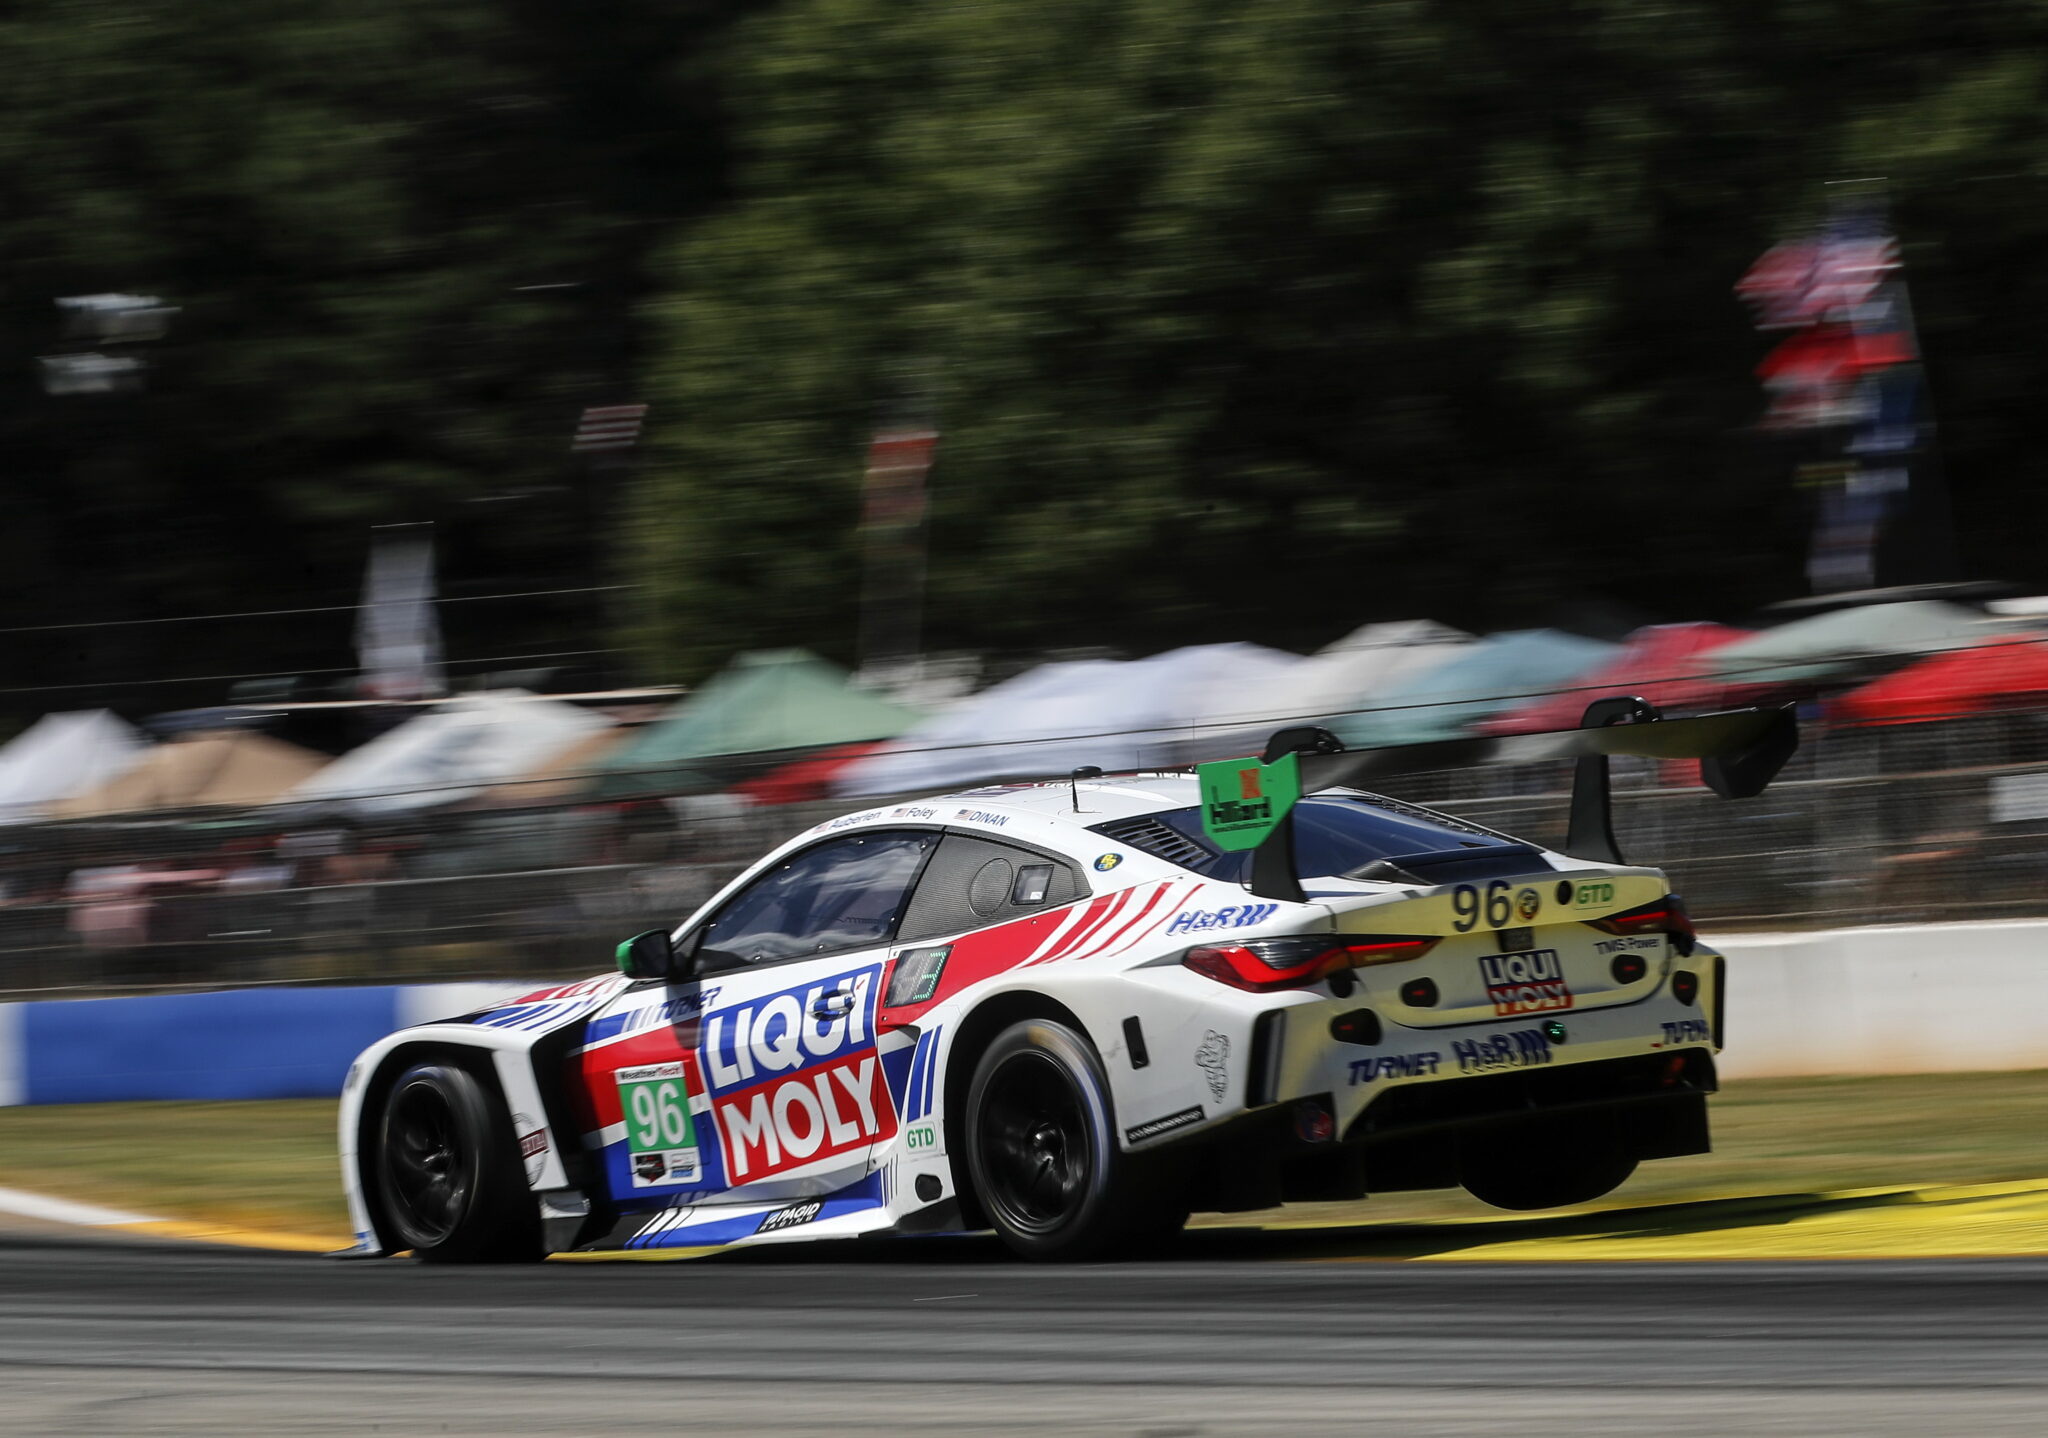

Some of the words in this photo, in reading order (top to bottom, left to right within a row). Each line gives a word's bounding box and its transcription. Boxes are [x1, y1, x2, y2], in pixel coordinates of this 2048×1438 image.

[906, 807, 938, 820] Foley
[969, 810, 1009, 827] DINAN
[1453, 880, 1511, 932] 96
[1576, 883, 1614, 905] GTD
[1482, 952, 1559, 985] LIQUI
[1491, 983, 1567, 1014] MOLY
[706, 972, 872, 1090] LIQUI
[1348, 1051, 1442, 1086] TURNER
[631, 1082, 686, 1148] 96
[721, 1056, 879, 1177] MOLY
[907, 1127, 935, 1148] GTD
